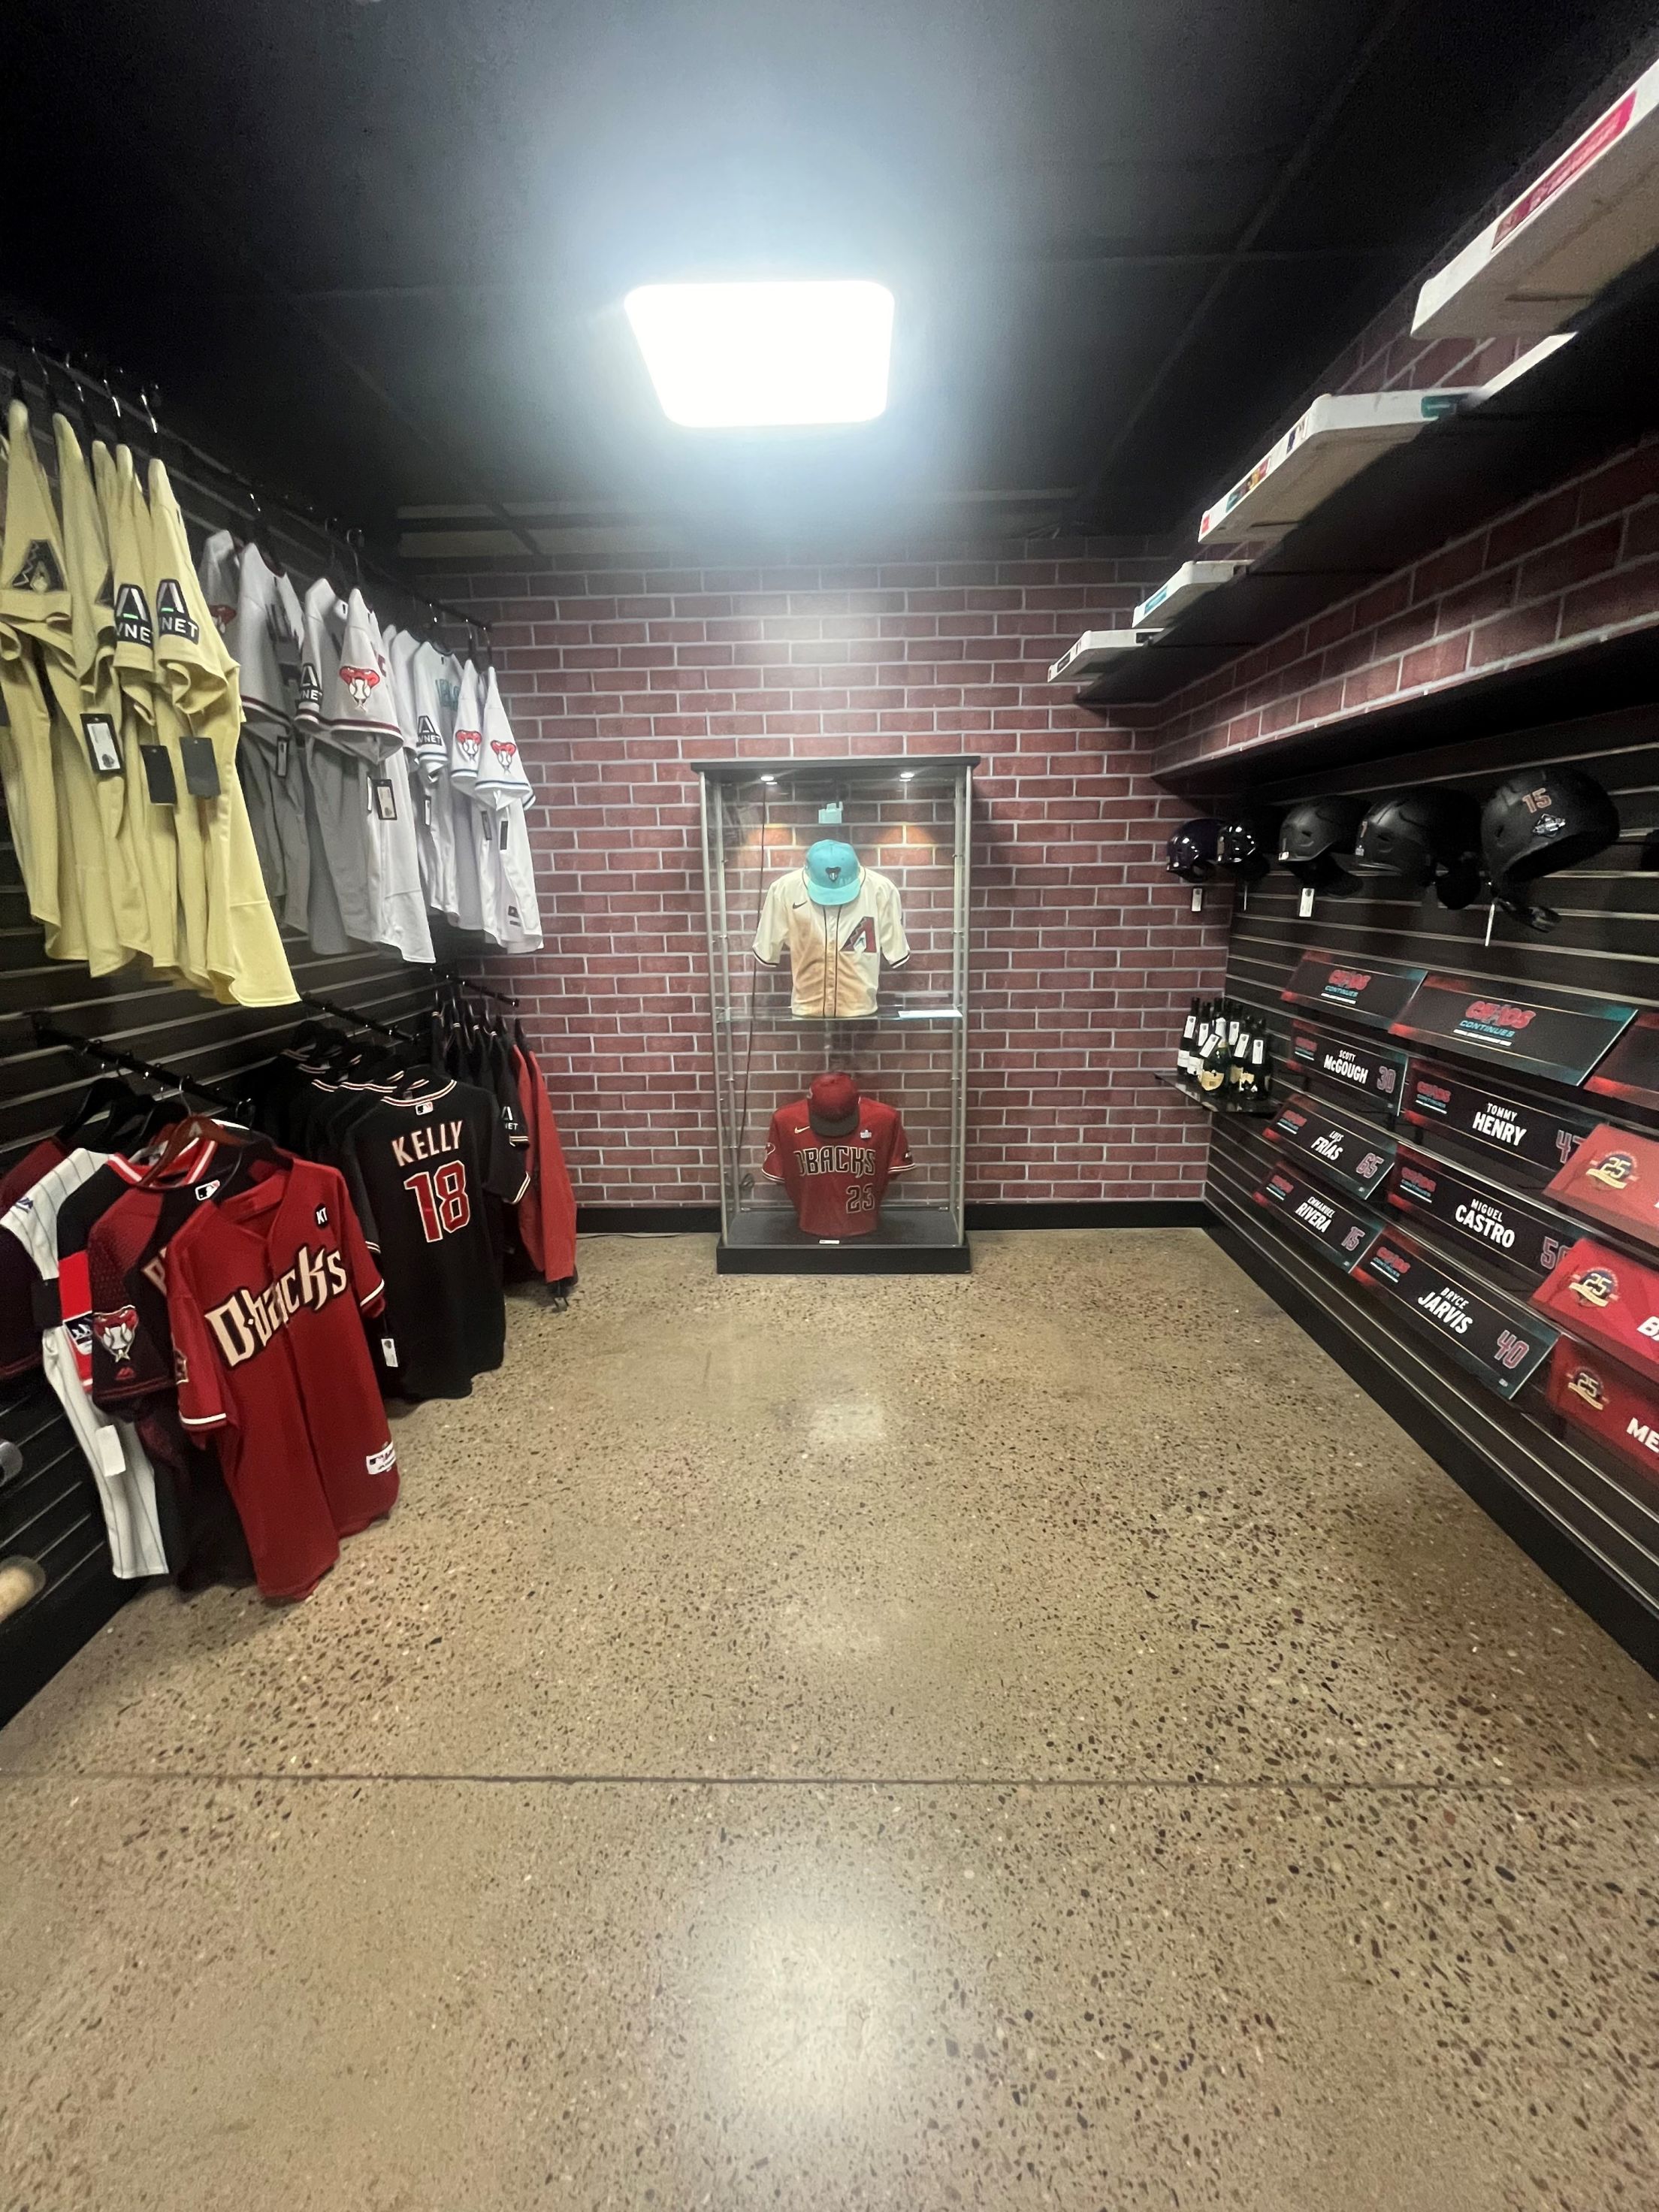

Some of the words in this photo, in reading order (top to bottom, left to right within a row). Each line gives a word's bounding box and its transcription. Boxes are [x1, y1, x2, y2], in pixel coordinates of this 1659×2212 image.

[1522, 787, 1552, 813] 15
[1459, 1020, 1515, 1038] CONTINUES
[1339, 1050, 1356, 1062] SCOTT
[1324, 1055, 1369, 1084] McGOUGH
[1487, 1102, 1518, 1123] TOMMY
[1473, 1112, 1528, 1147] HENRY
[391, 1120, 463, 1167] KELLY
[1355, 1153, 1384, 1179] 65
[1602, 1156, 1631, 1179] 25
[403, 1160, 471, 1243] 18
[846, 1183, 875, 1213] 23
[1470, 1198, 1503, 1222] MIGUEL
[316, 1207, 328, 1225] KT
[1295, 1202, 1331, 1233] RIVERA
[1455, 1204, 1515, 1248] CASTRO
[1583, 1273, 1612, 1295] 25
[1440, 1287, 1469, 1310] BRYCE
[1418, 1292, 1473, 1334] JARVIS
[1494, 1329, 1530, 1370] 40
[1578, 1372, 1599, 1398] 25
